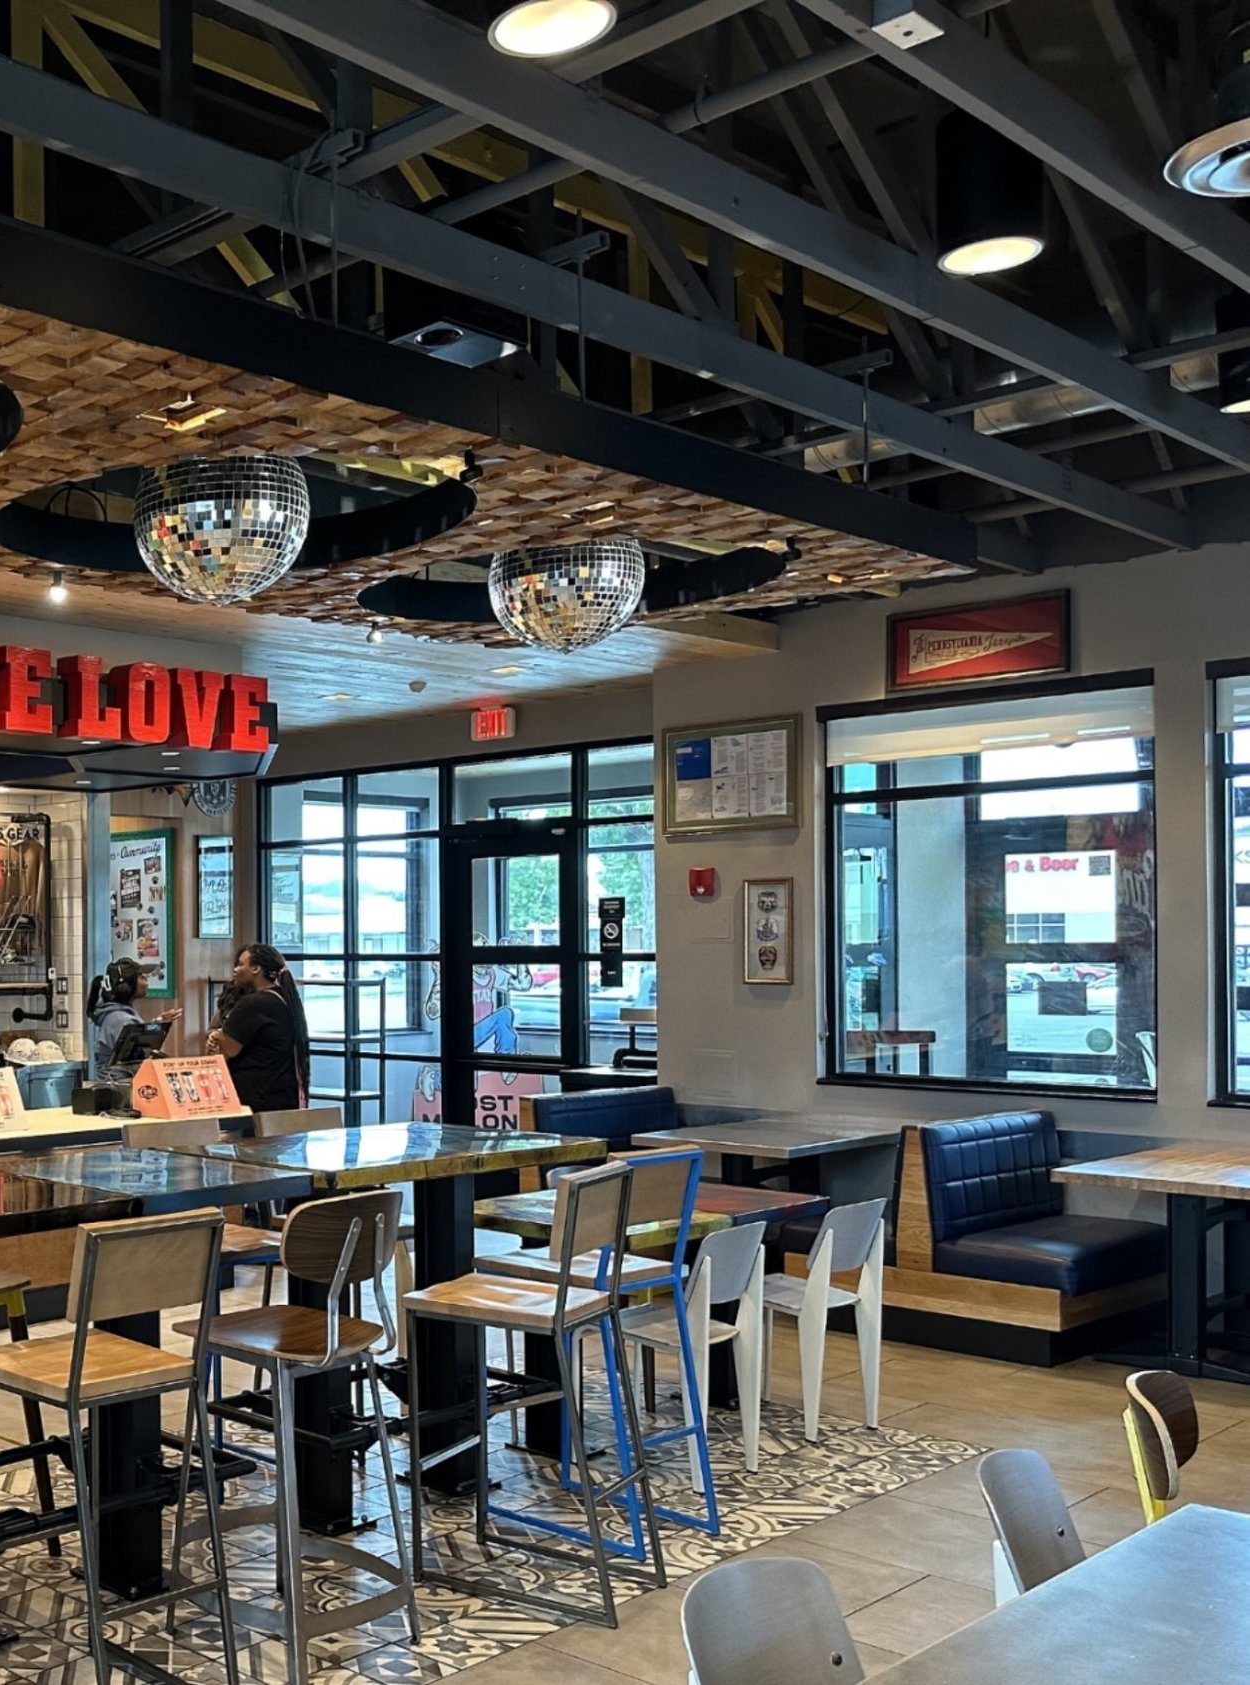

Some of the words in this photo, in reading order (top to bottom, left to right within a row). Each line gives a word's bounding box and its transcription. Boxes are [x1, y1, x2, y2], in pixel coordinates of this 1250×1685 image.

[928, 635, 983, 651] PENNSYLVANIA
[62, 655, 270, 753] LOVE
[477, 709, 508, 739] EXIT
[6, 826, 40, 840] GEAR
[1024, 859, 1035, 873] &
[1039, 856, 1079, 872] Beer
